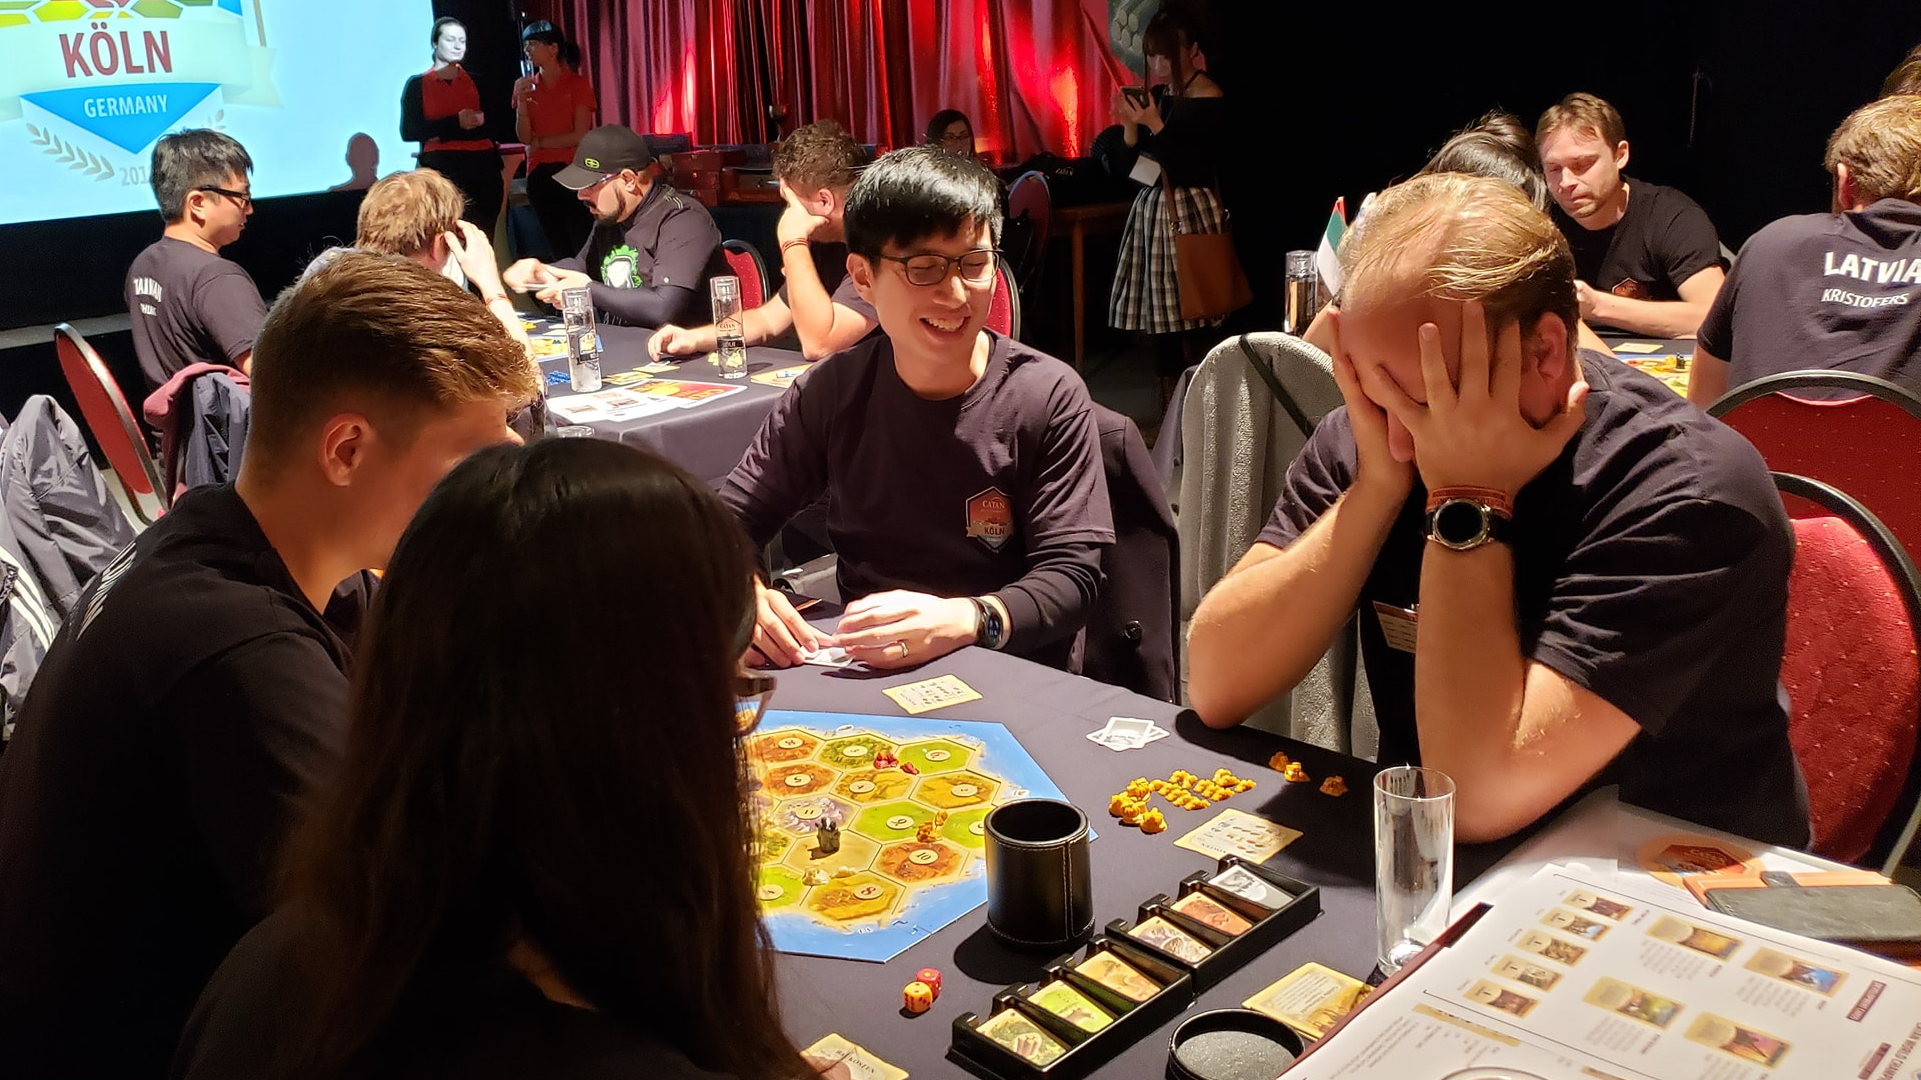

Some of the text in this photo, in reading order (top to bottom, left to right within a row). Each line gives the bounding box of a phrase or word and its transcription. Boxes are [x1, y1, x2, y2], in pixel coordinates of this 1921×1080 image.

[58, 21, 173, 79] KÖLN
[83, 94, 168, 118] GERMANY
[119, 166, 152, 186] 201
[1823, 251, 1921, 284] LATVIA
[1820, 288, 1910, 308] KRISTOFERS
[982, 500, 1005, 509] CATAN
[984, 526, 1005, 536] KÖLN
